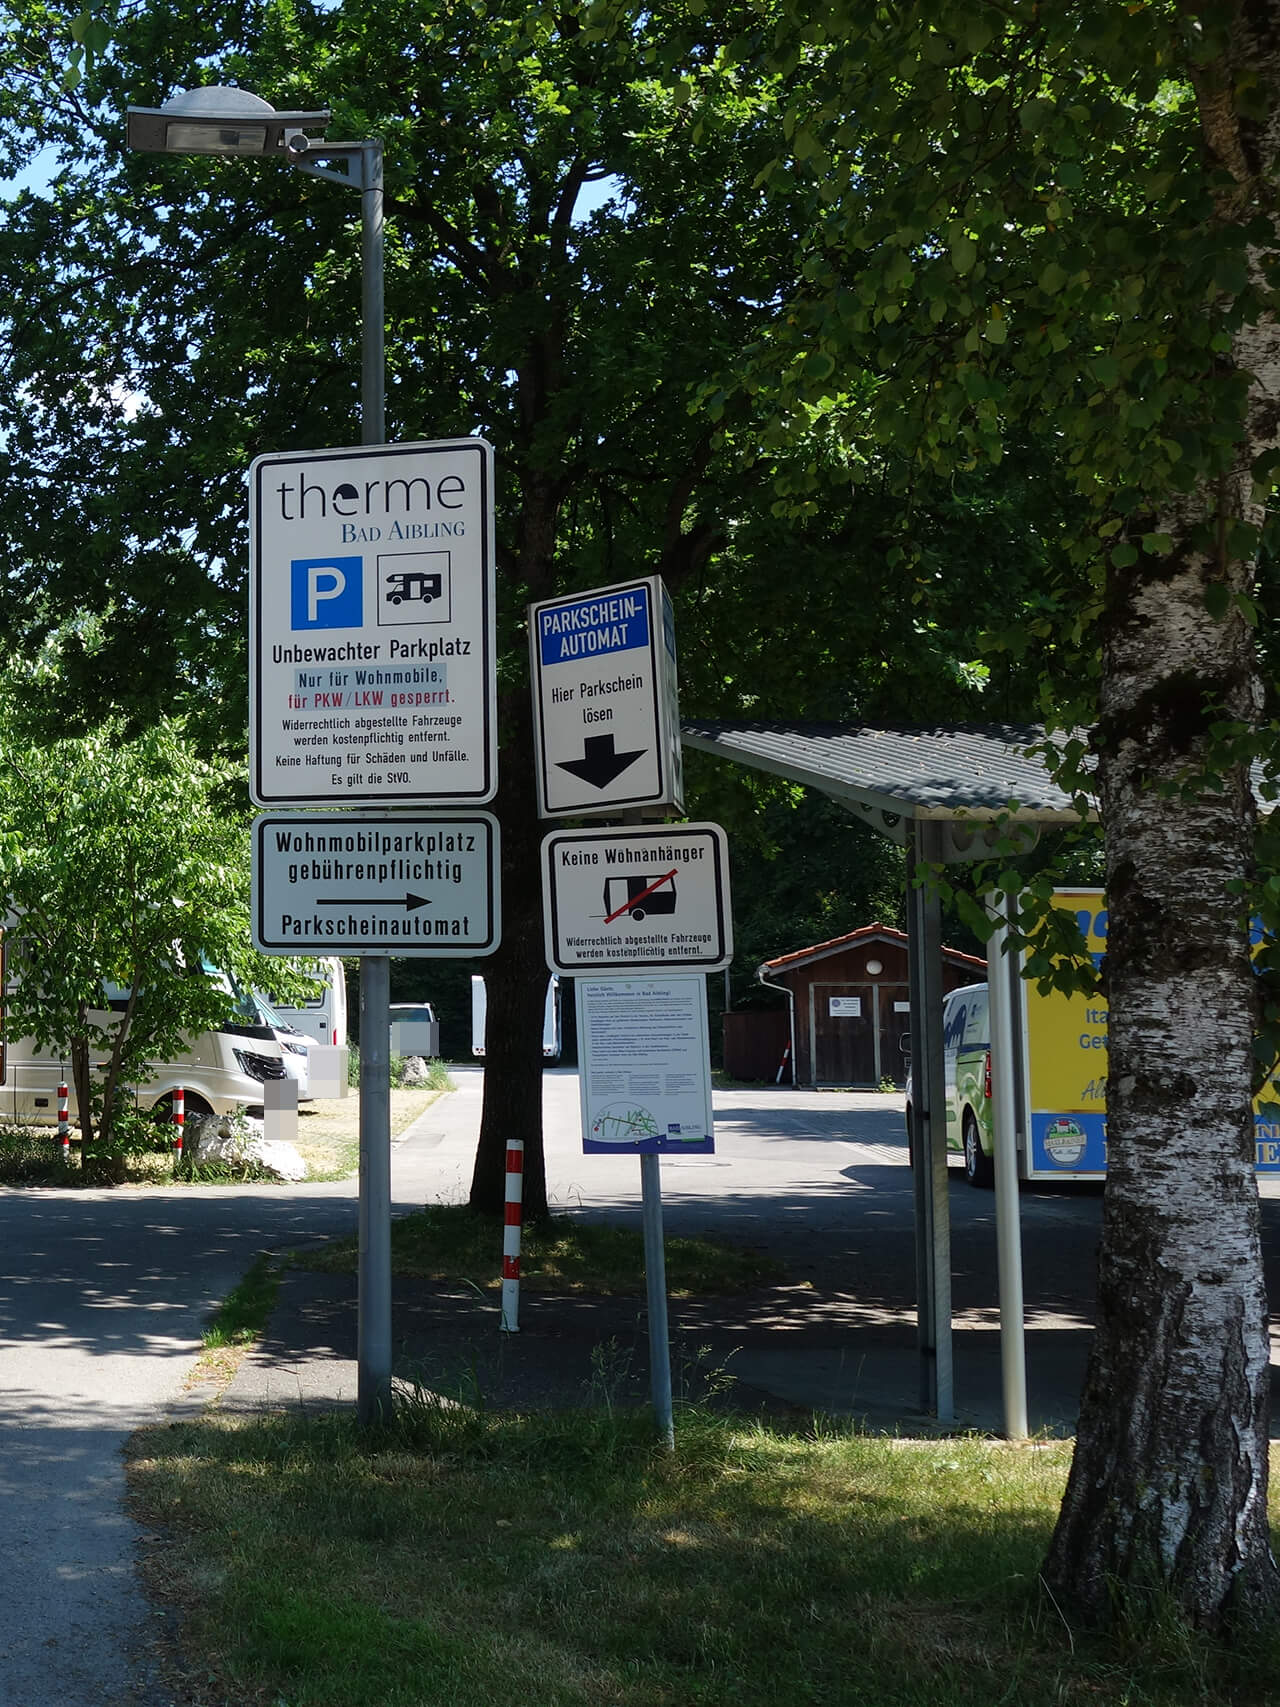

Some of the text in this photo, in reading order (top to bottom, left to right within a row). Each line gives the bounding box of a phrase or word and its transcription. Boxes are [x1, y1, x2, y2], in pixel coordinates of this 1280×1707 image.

[276, 473, 466, 520] therme
[308, 567, 345, 621] P
[543, 596, 643, 636] PARKSCHEIN-
[273, 638, 470, 663] Unbewachter Parkplatz
[560, 623, 629, 658] AUTOMAT
[300, 668, 442, 688] Nur für Wohnmobile,
[288, 693, 308, 709] für
[391, 688, 456, 708] gesperrt.
[552, 674, 642, 703] Hier Parkschein
[283, 715, 462, 730] Widerrechtlich abgestellte Fahrzeuge
[583, 708, 612, 723] lösen
[294, 731, 450, 746] werden kostenpflichtig entfernt.
[276, 750, 469, 767] Keine Haftung für Schäden und Unfälle.
[332, 772, 411, 787] Es gilt die StVO.
[276, 832, 475, 855] Wohnmobilparkplatz
[562, 846, 704, 866] Keine Wohnanhänger
[289, 859, 461, 883] gebührenpflichtig
[282, 915, 468, 935] Parkscheinautomat
[566, 933, 712, 946] Widerrechtlich abgestellte Fahrzeuge
[576, 945, 704, 958] werden kostenpflichtig entfernt.
